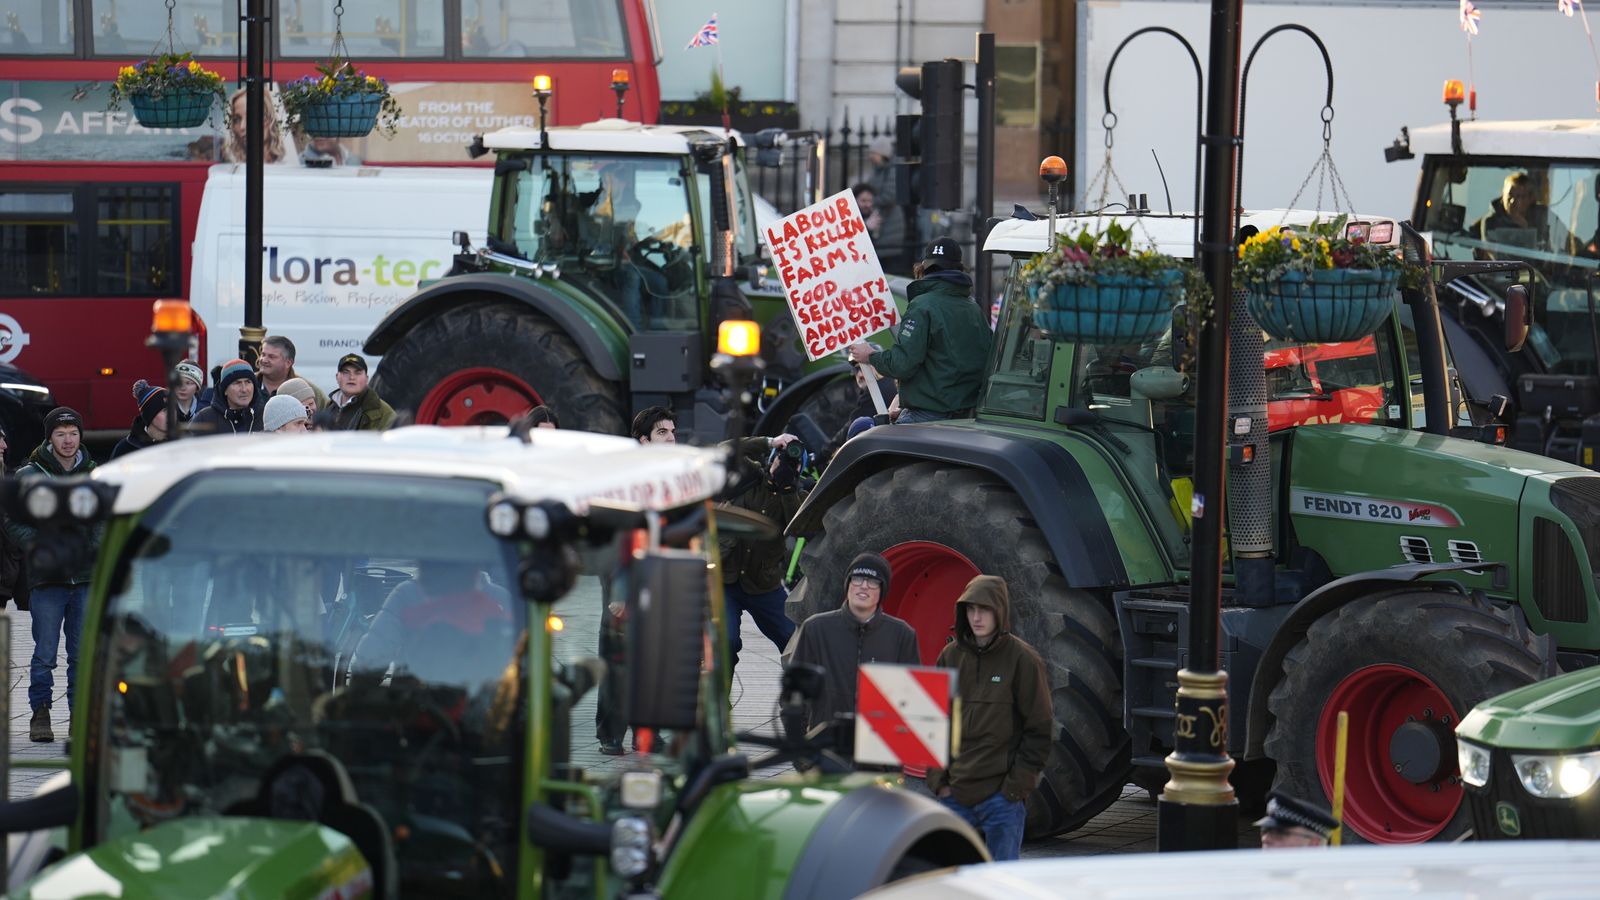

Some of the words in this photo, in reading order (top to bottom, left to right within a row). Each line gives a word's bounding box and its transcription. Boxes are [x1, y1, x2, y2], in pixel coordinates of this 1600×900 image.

[418, 101, 462, 113] FROM
[466, 101, 494, 113] THE
[452, 116, 470, 128] OF
[476, 115, 534, 128] LUTHER
[54, 111, 189, 135] AFFA
[767, 197, 851, 246] LABOUR
[262, 246, 441, 287] lora-tec
[773, 240, 803, 268] IS
[782, 241, 869, 289] FARMS,
[790, 280, 838, 310] FOOD
[806, 316, 846, 344] AND
[849, 298, 886, 323] OUR
[811, 308, 897, 356] COUNTRY
[1303, 495, 1362, 516] FENDT
[1368, 503, 1402, 520] 820
